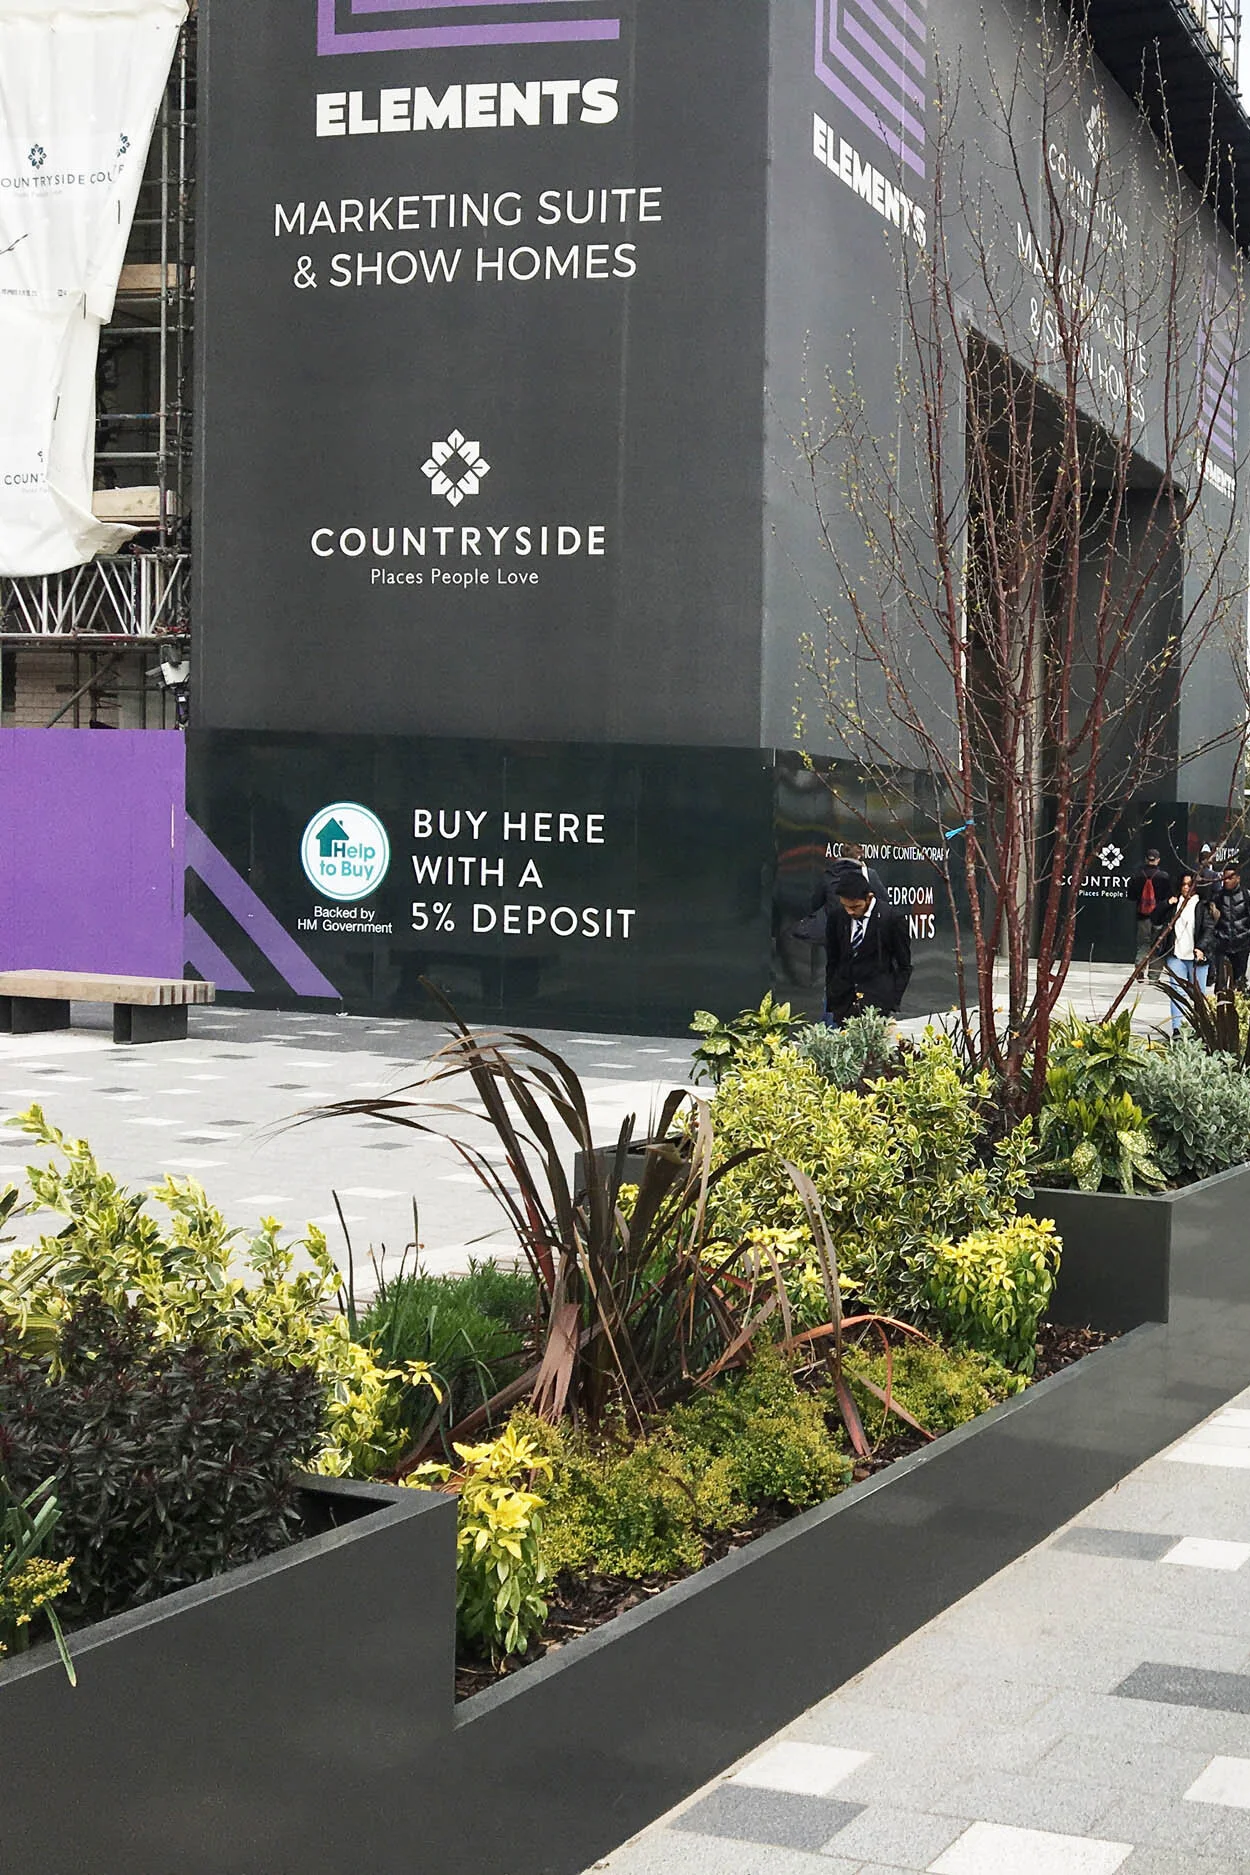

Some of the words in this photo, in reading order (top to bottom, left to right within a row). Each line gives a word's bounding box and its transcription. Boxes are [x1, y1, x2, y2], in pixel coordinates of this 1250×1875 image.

[316, 77, 619, 137] ELEMENTS
[0, 173, 86, 189] OUNTRYSIDE
[813, 111, 927, 248] ELEMENTS
[274, 193, 523, 237] MARKETING
[536, 186, 663, 225] SUITE
[293, 255, 318, 290] &
[329, 247, 462, 287] SHOW
[476, 243, 637, 282] HOMES
[310, 526, 605, 557] COUNTRYSIDE
[371, 568, 423, 584] Places
[431, 569, 489, 588] People
[497, 569, 539, 584] Love
[414, 809, 488, 840] BUY
[503, 811, 605, 844] HERE
[333, 842, 376, 862] Help
[825, 842, 832, 858] A
[880, 845, 891, 859] OF
[320, 861, 337, 876] to
[341, 861, 374, 880] Buy
[412, 855, 504, 887] WITH
[518, 858, 544, 888] A
[887, 886, 934, 905] EDROOM
[1101, 890, 1123, 899] People
[314, 905, 358, 919] Backed
[360, 908, 375, 922] by
[411, 902, 455, 932] 5%
[473, 904, 636, 938] DEPOSIT
[297, 919, 318, 930] HM
[322, 919, 393, 934] Government
